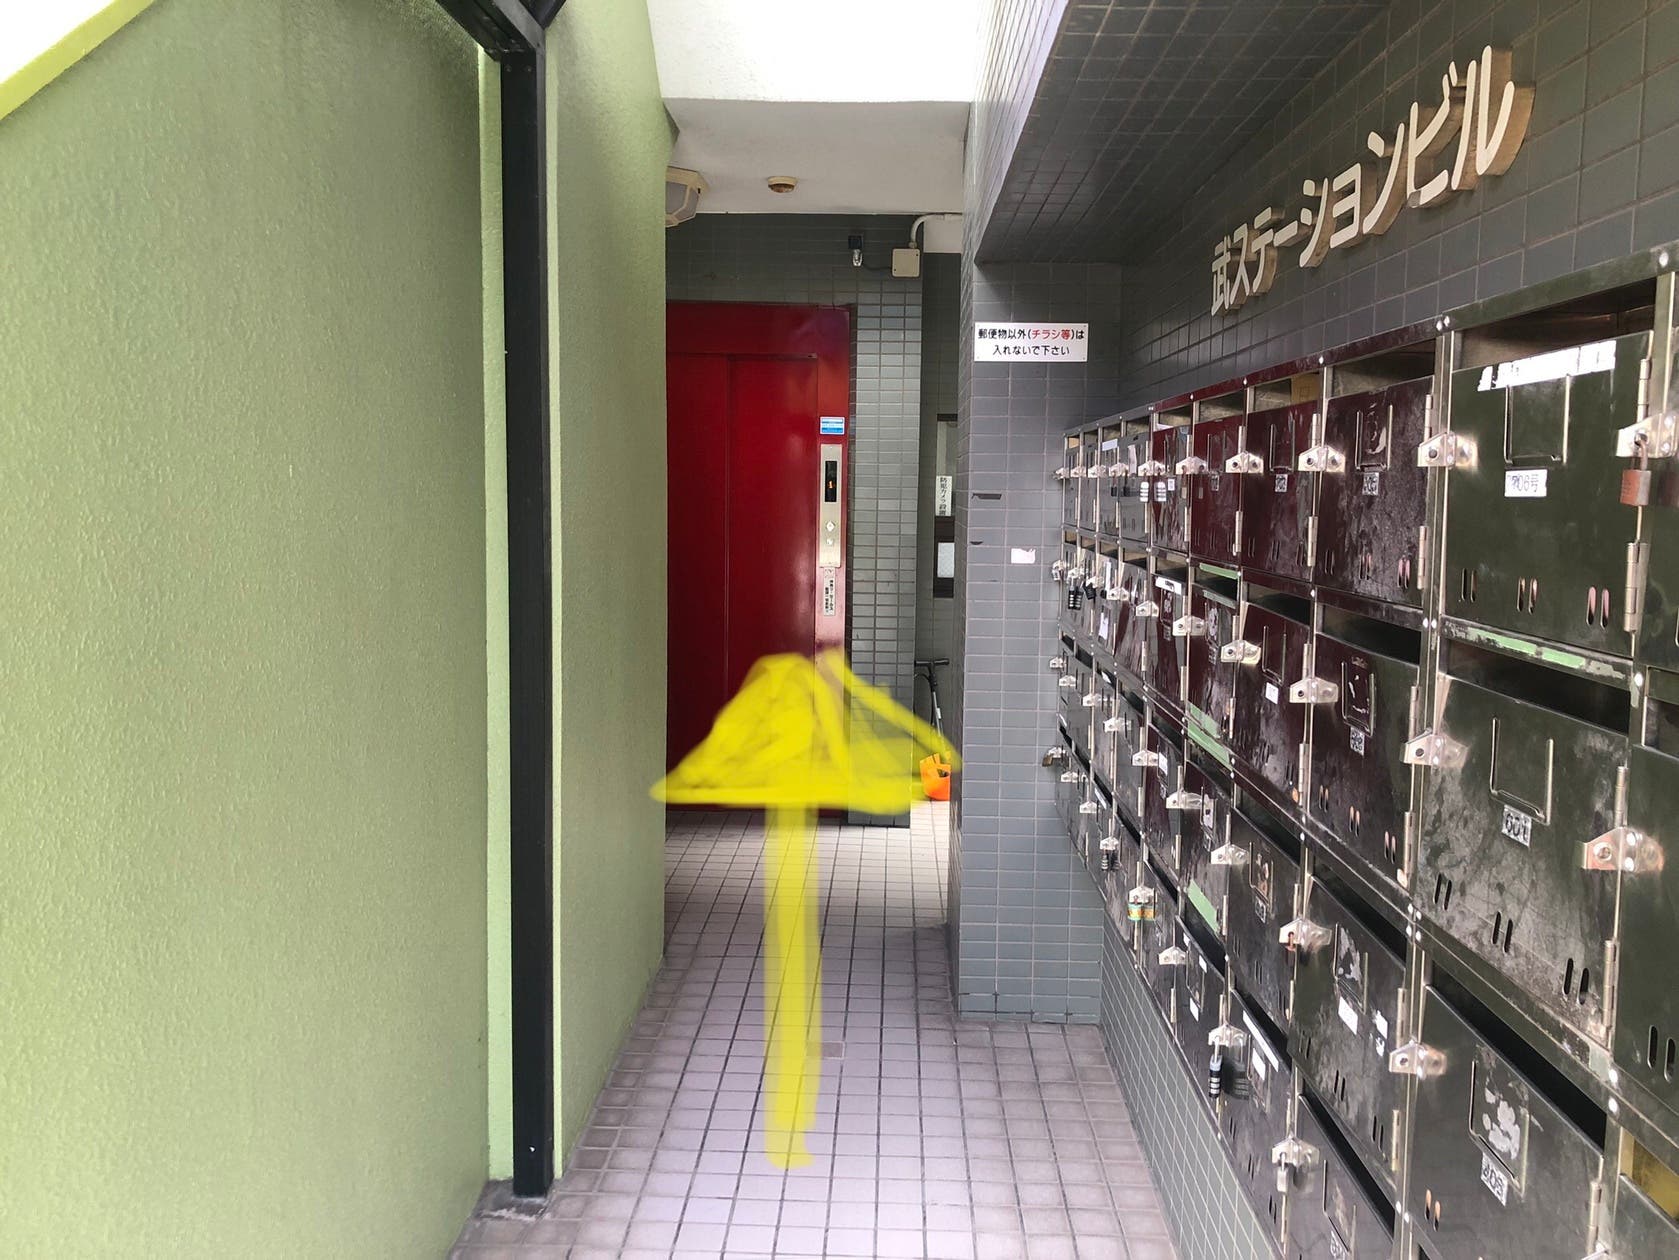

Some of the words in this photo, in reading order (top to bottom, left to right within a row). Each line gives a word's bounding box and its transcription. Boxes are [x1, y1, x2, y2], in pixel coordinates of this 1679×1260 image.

[1211, 44, 1517, 317] 武ステーションビル
[977, 328, 1085, 340] 郵便物以外(チラシ等)は
[992, 344, 1070, 356] 入れないで下さい
